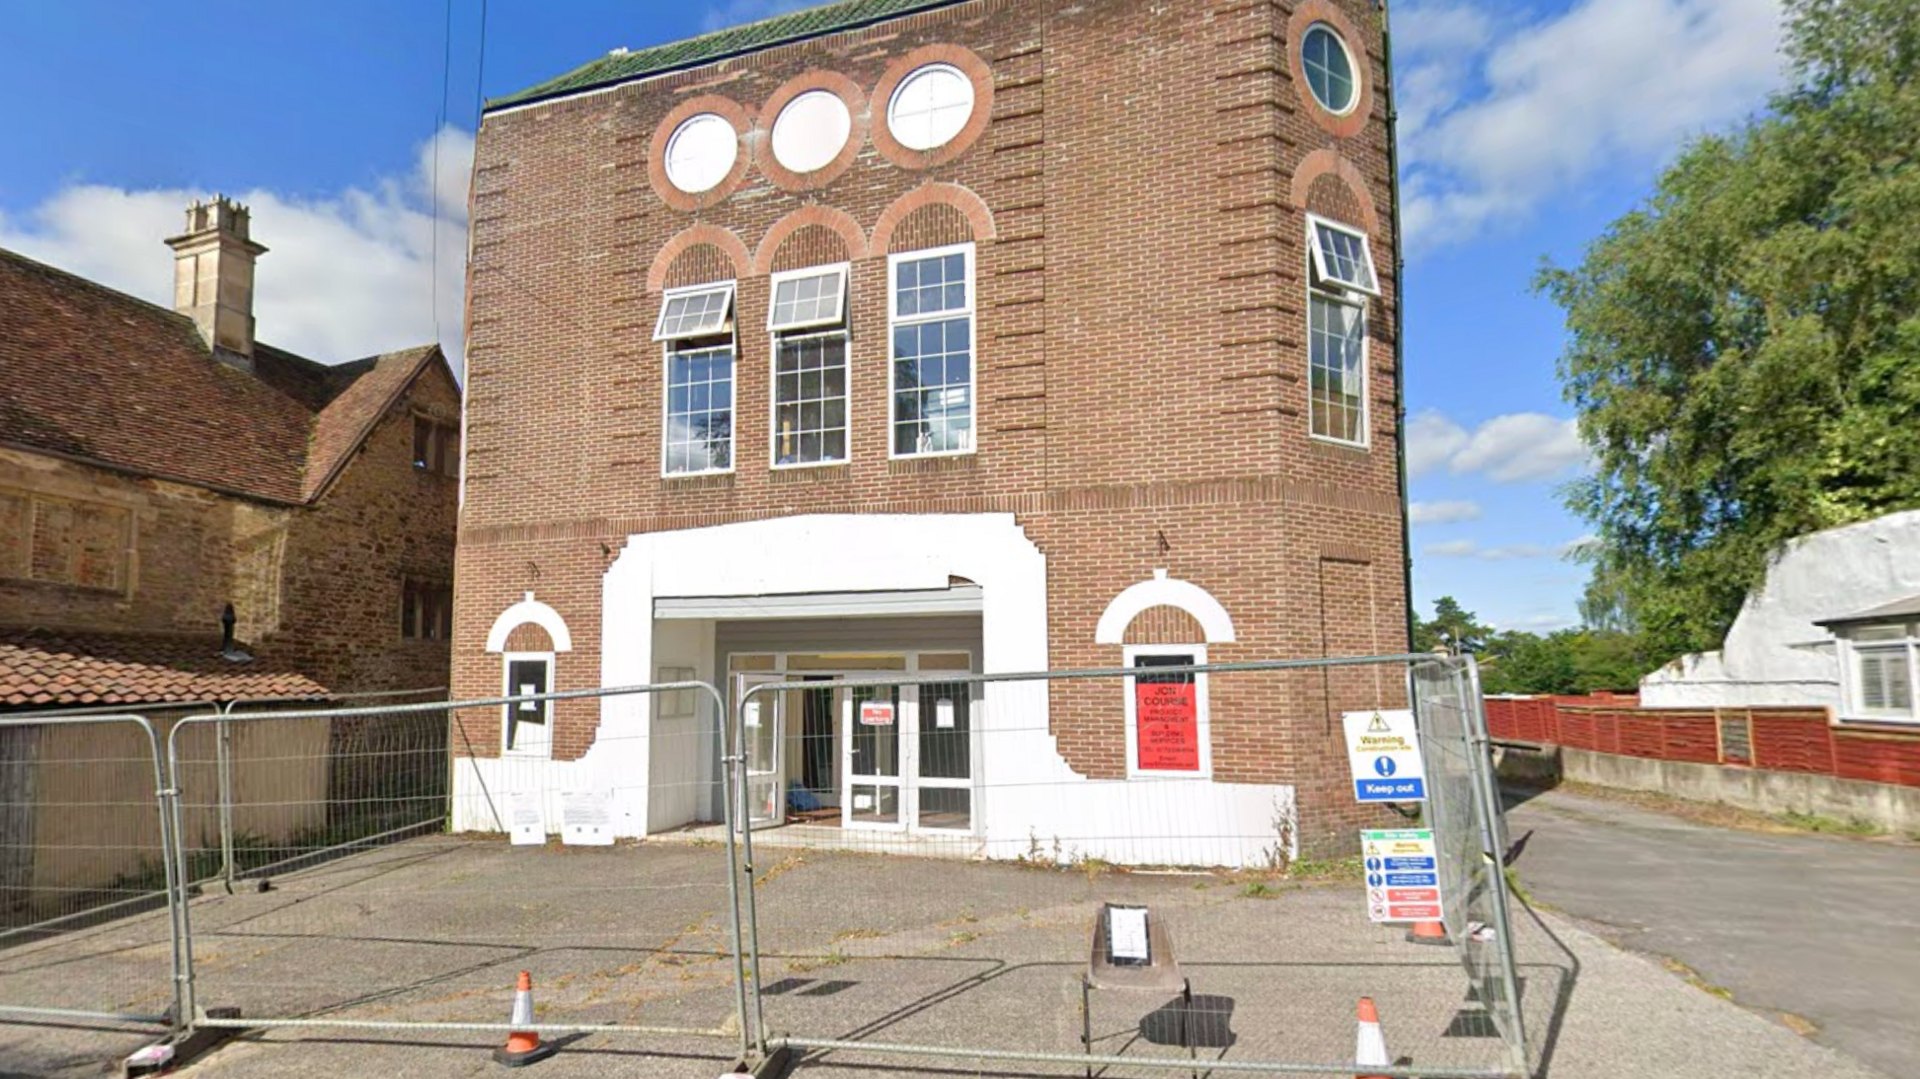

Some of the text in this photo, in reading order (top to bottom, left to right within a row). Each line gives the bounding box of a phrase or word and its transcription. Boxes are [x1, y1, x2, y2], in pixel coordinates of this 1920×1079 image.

[1154, 686, 1177, 695] JON
[1144, 696, 1189, 706] COURSE
[1360, 735, 1404, 746] Warning
[1365, 783, 1415, 794] Keep out
